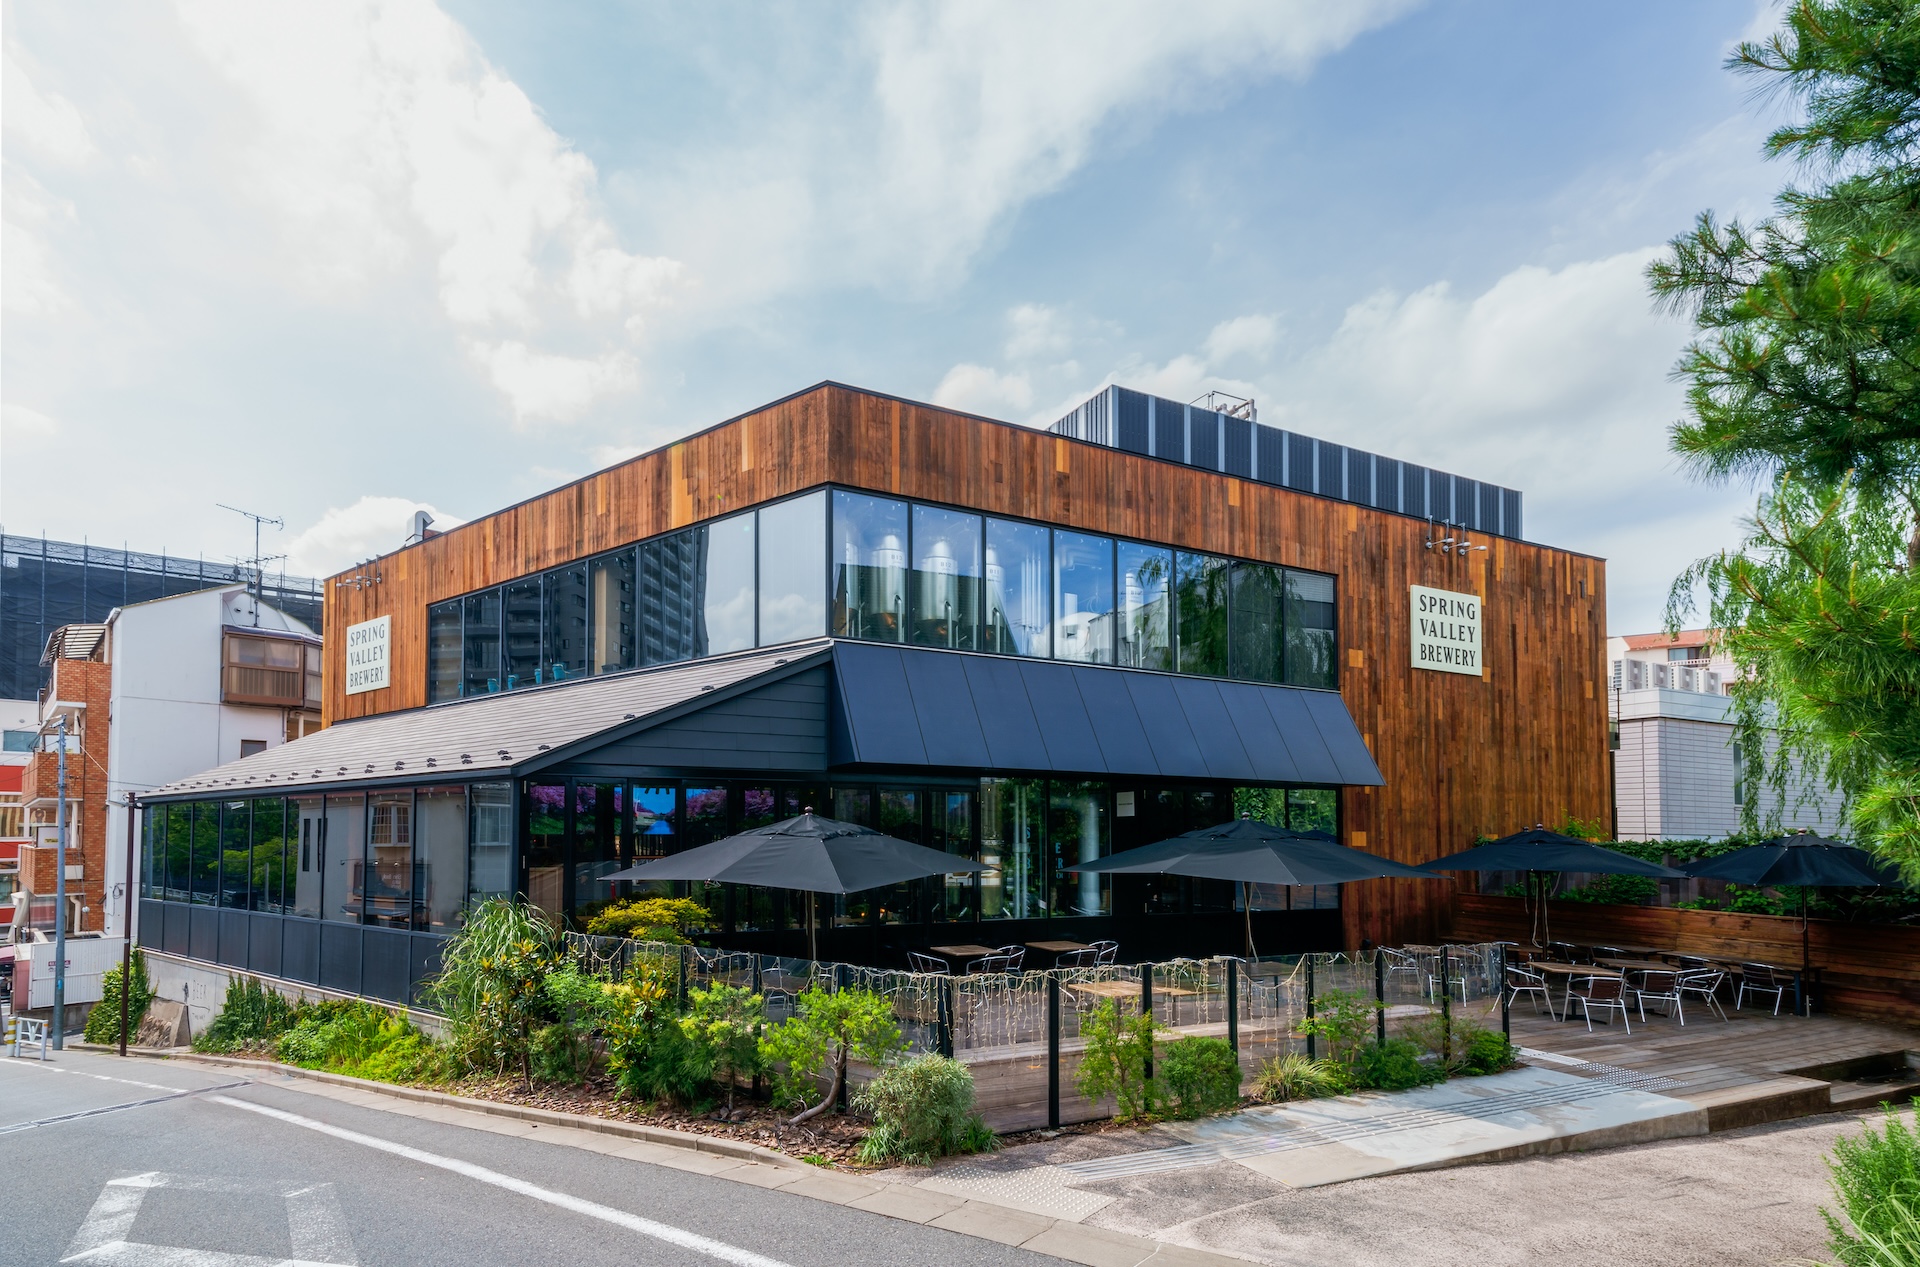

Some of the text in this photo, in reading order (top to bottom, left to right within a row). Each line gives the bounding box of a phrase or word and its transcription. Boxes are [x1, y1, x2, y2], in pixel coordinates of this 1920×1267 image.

[1419, 594, 1475, 620] SPRING
[350, 624, 385, 647] SPRING
[1419, 618, 1475, 643] VALLEY
[350, 644, 385, 667] VALLEY
[1420, 643, 1476, 667] BREWERY
[350, 666, 384, 688] BREWERY
